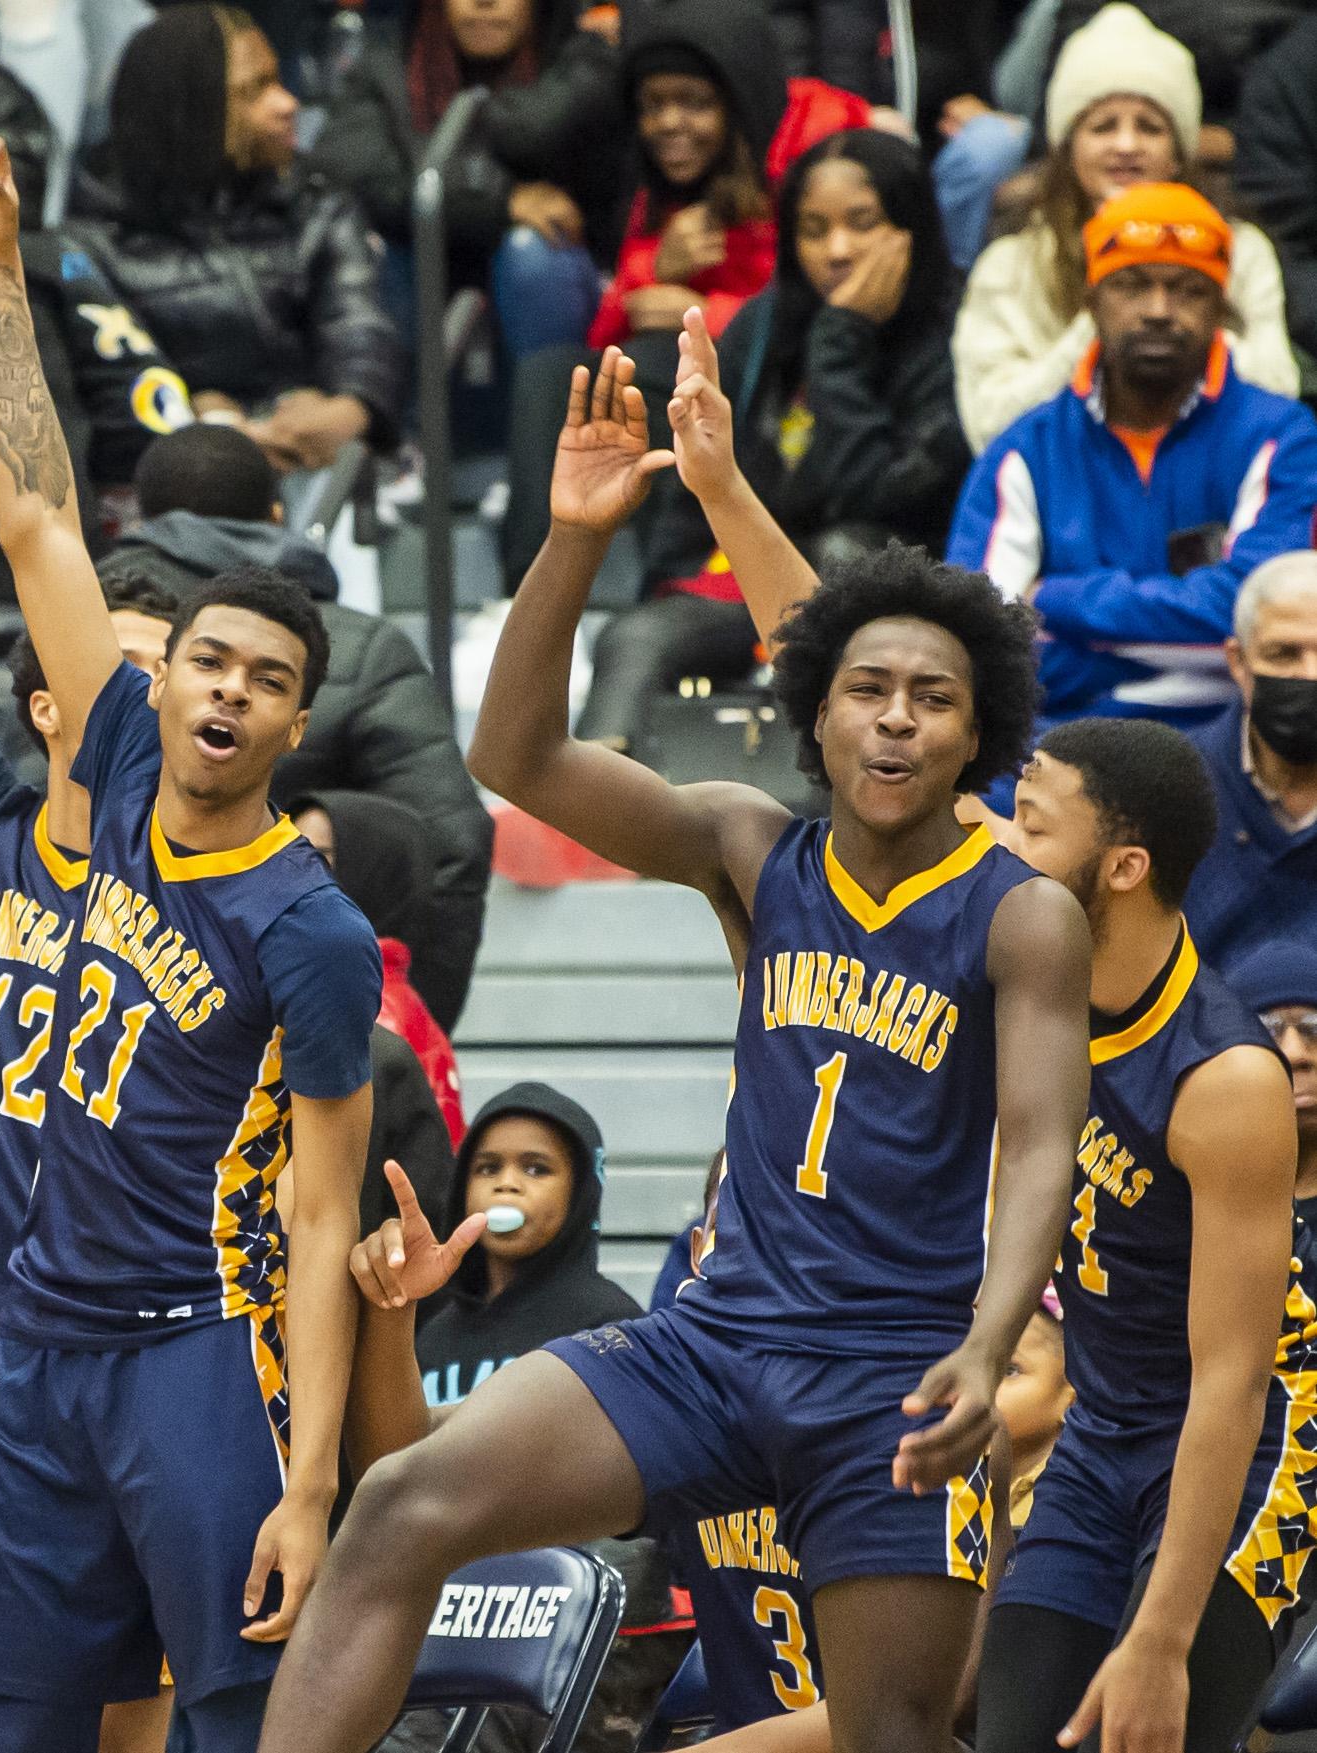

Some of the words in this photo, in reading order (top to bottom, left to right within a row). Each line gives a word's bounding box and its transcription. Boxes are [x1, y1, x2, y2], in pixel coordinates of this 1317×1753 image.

[58, 959, 157, 1130] 21
[763, 951, 959, 1074] LUMBERJACKS
[796, 1050, 848, 1200] 1
[753, 1585, 820, 1711] 3
